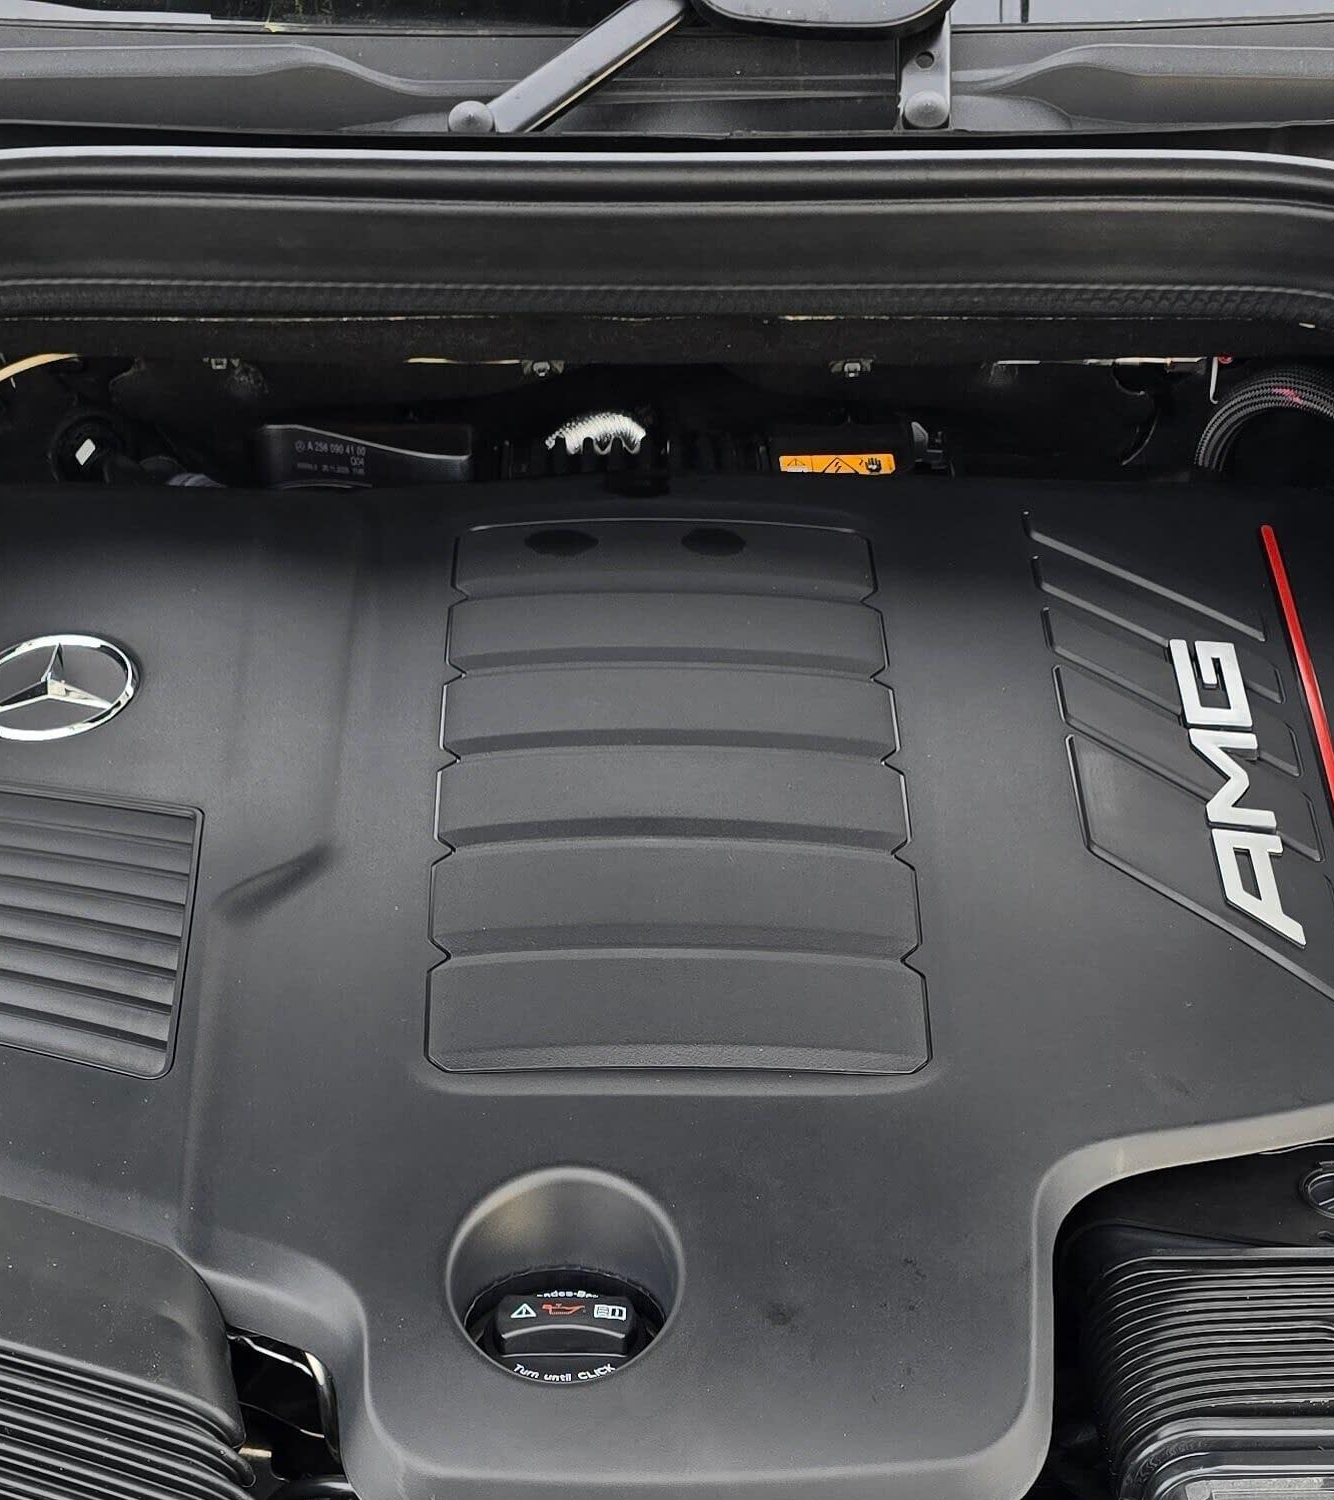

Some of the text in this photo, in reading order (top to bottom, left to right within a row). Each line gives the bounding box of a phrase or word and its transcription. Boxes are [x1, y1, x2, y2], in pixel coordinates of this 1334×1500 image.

[1169, 639, 1307, 948] AMG
[513, 1362, 616, 1382] Turn until CLICK
